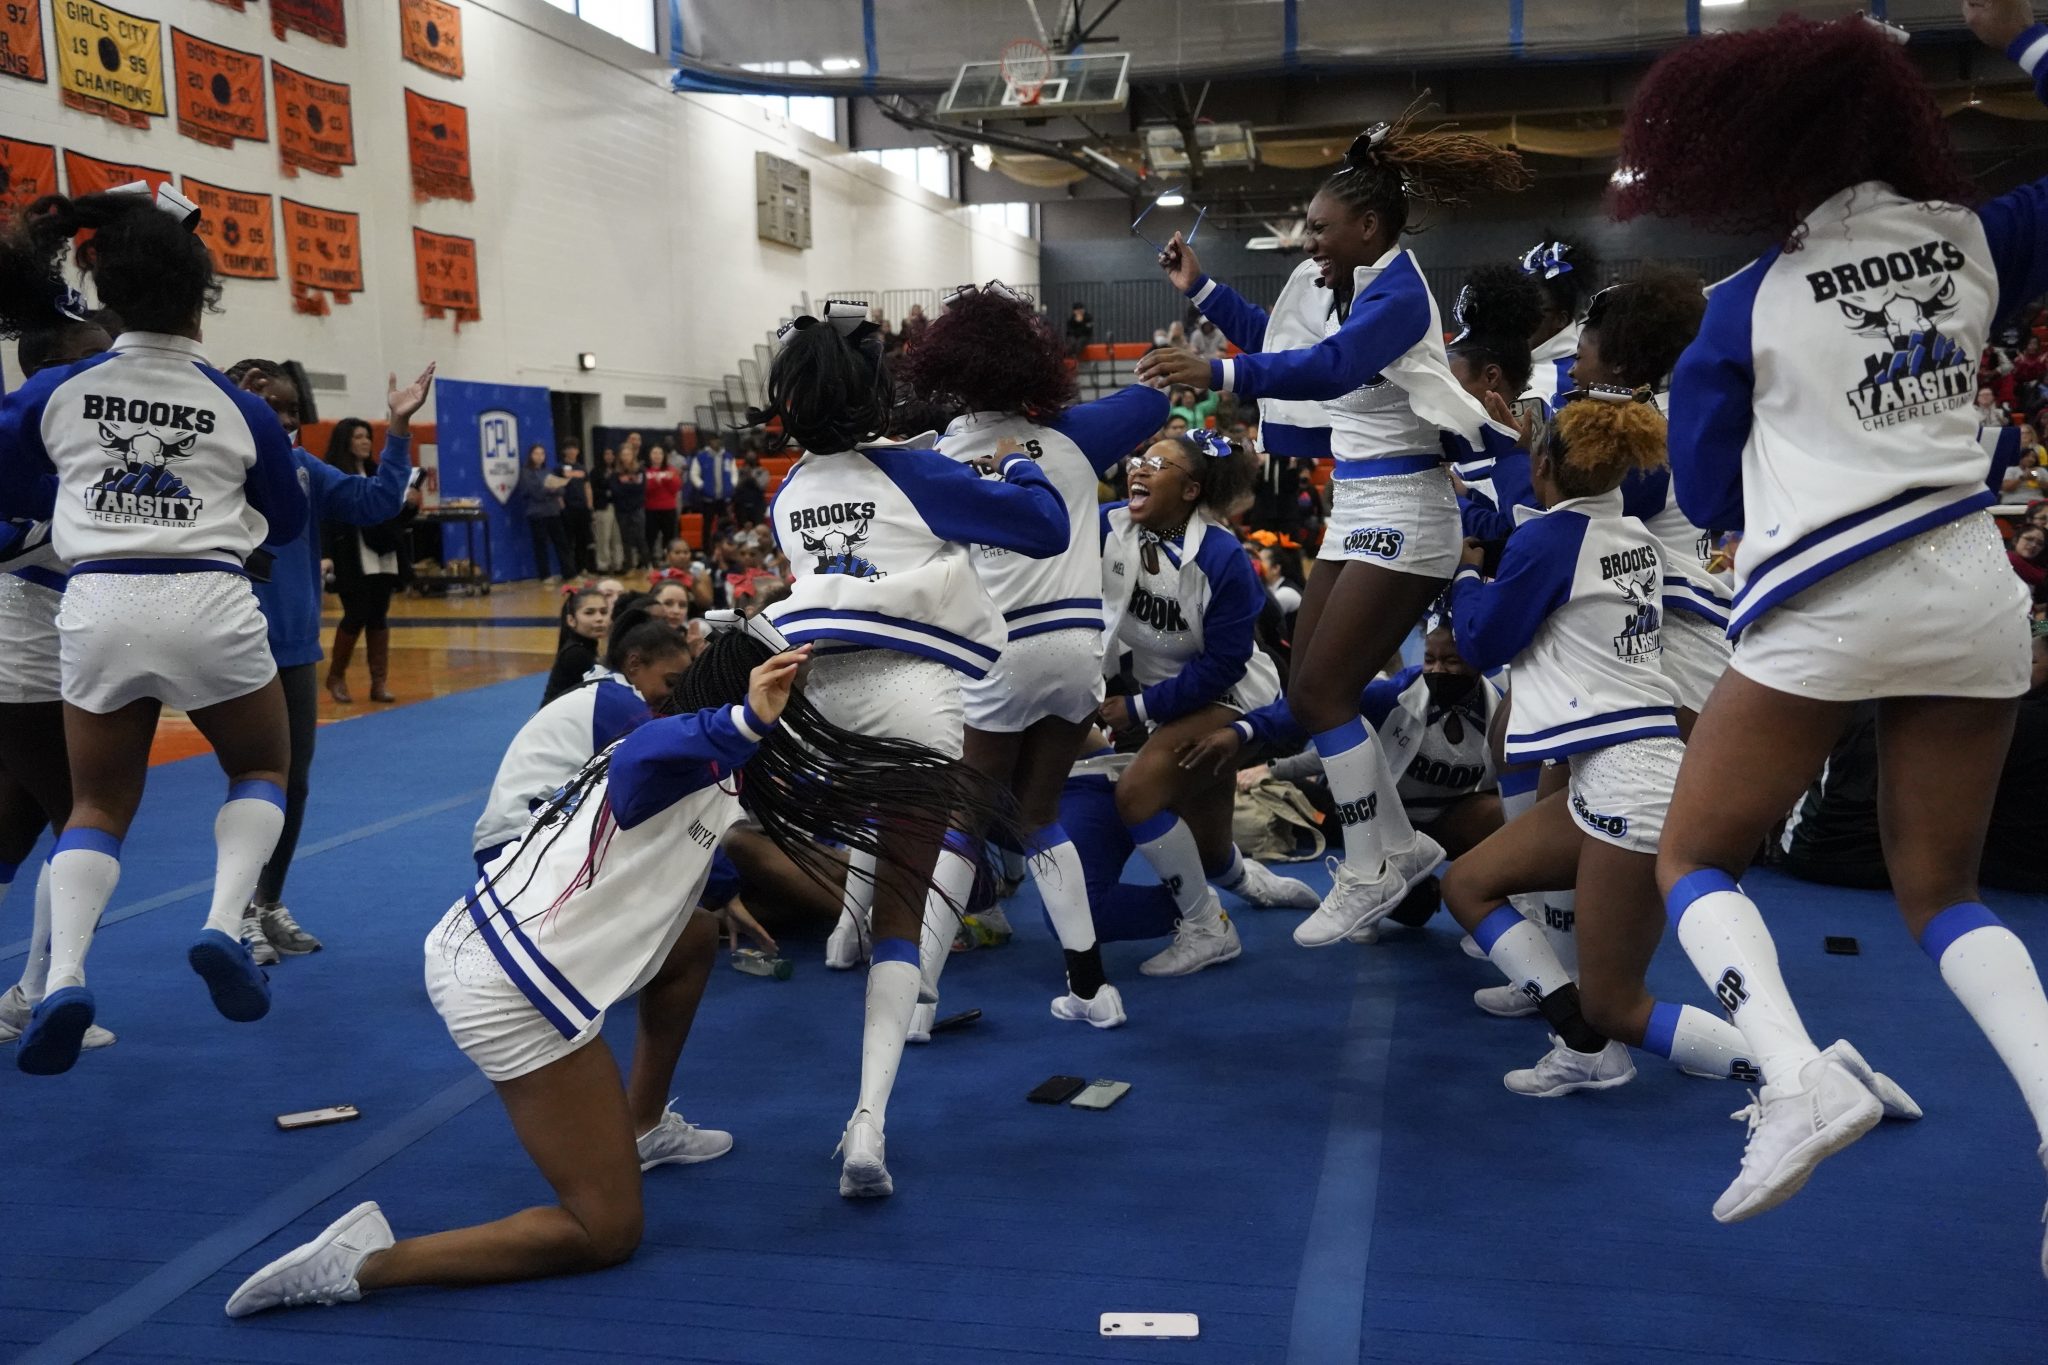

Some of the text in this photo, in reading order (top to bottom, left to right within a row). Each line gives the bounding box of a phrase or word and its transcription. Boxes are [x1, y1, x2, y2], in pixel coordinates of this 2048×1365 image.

[6, 3, 28, 25] 97
[66, 1, 149, 44] GIRLS CITY
[73, 36, 148, 75] 19 99
[186, 41, 217, 67] BOYS
[74, 68, 153, 106] CHAMPIONS
[187, 70, 204, 91] 20
[191, 100, 255, 134] CHAMPIONS
[1806, 240, 1966, 303] BROOKS
[1846, 360, 1975, 420] VARSITY
[83, 394, 216, 434] BROOKS
[484, 418, 516, 458] CPL
[84, 487, 203, 520] VARSITY
[87, 510, 197, 528] HEERLEADING
[790, 501, 876, 532] BROOKS
[1599, 545, 1657, 580] BROOKS
